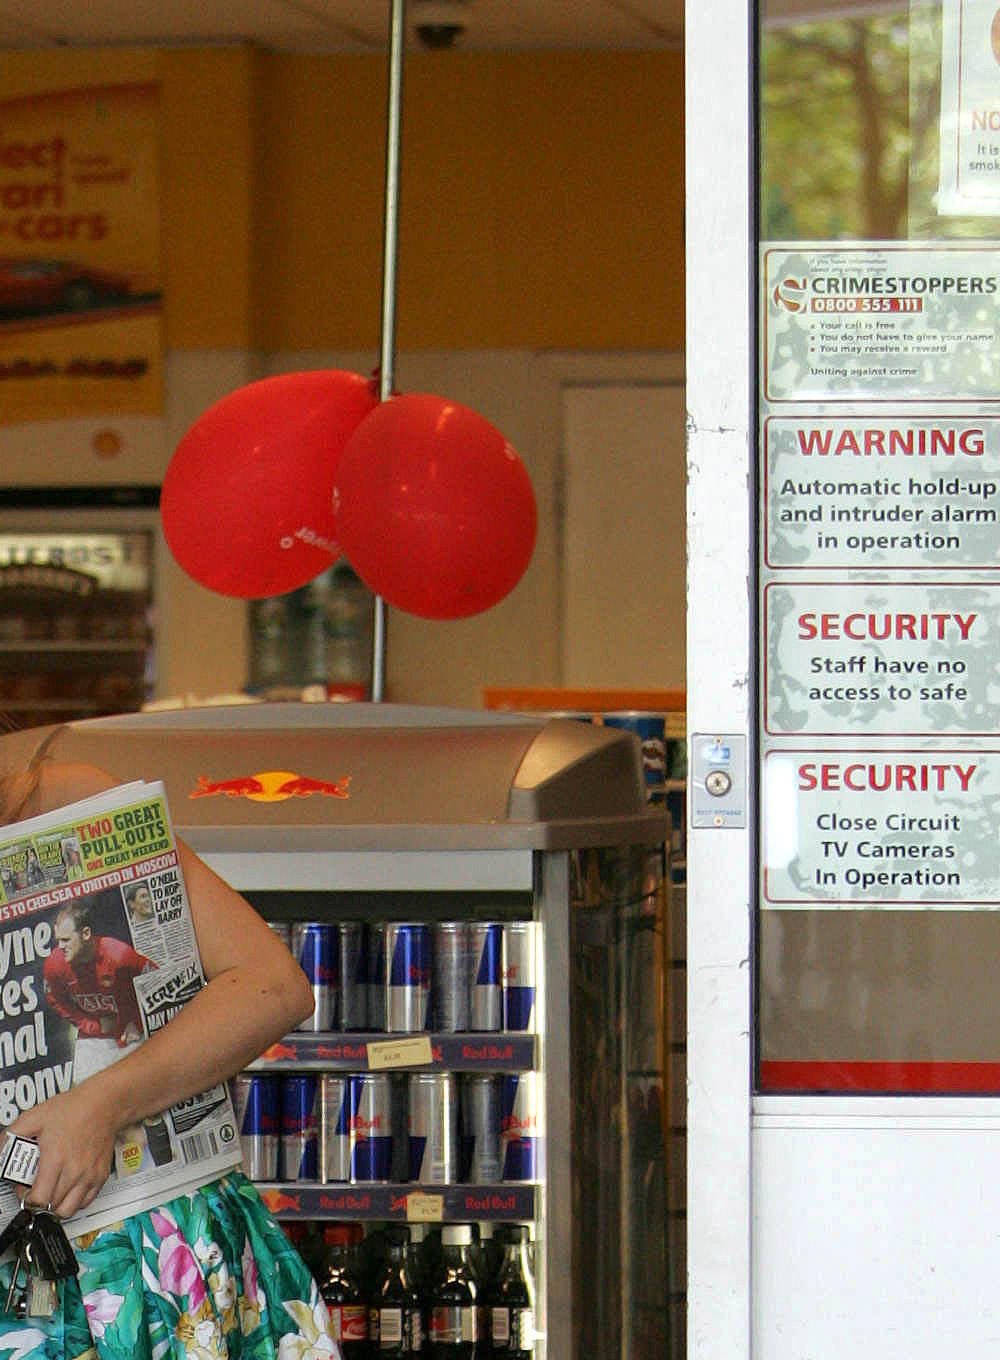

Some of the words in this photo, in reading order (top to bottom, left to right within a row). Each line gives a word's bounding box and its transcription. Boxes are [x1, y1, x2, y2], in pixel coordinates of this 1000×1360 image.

[978, 144, 986, 154] It
[15, 214, 109, 241] cars
[811, 278, 997, 293] CRIMESTOPPERS
[815, 299, 856, 311] 0800
[862, 299, 890, 311] 555
[898, 299, 919, 311] 111
[845, 320, 862, 329] call
[841, 346, 861, 354] may
[811, 368, 847, 377] Uniting
[851, 368, 886, 377] against
[798, 429, 985, 456] WARNING
[780, 478, 901, 496] Automatic
[908, 478, 997, 500] hold-up
[780, 506, 822, 522] and
[830, 506, 924, 522] intruder
[931, 506, 996, 522] alarm
[817, 532, 838, 548] in
[846, 532, 960, 552] operation
[798, 614, 977, 640] SECURITY
[810, 656, 866, 674] Staff
[874, 657, 929, 674] have
[937, 661, 966, 674] no
[809, 687, 880, 700] access
[888, 685, 912, 700] to
[920, 684, 968, 700] safe
[798, 764, 977, 791] SECURITY
[76, 819, 113, 841] TWO
[113, 803, 161, 831] GREAT
[817, 814, 877, 831] Close
[885, 814, 961, 831] Circuit
[80, 820, 166, 860] PULL-OUTS
[104, 850, 130, 866] GREAT
[131, 839, 169, 859] WEEKEND
[821, 841, 848, 857] TV
[857, 841, 955, 858] Cameras
[10, 901, 27, 918] TO
[28, 889, 74, 914] CHELSEA
[82, 875, 122, 896] UNITED
[135, 852, 178, 877] MOSCOW
[816, 869, 836, 885] In
[845, 869, 960, 889] Operation
[155, 899, 169, 912] LAY
[170, 894, 182, 908] OFF
[158, 908, 183, 925] BARRY
[317, 1045, 341, 1057] Red
[462, 1045, 488, 1059] Red
[488, 1045, 513, 1059] Bull
[319, 1195, 345, 1209] Red
[346, 1195, 371, 1209] Bull
[466, 1196, 489, 1209] Red
[491, 1197, 515, 1209] Bull
